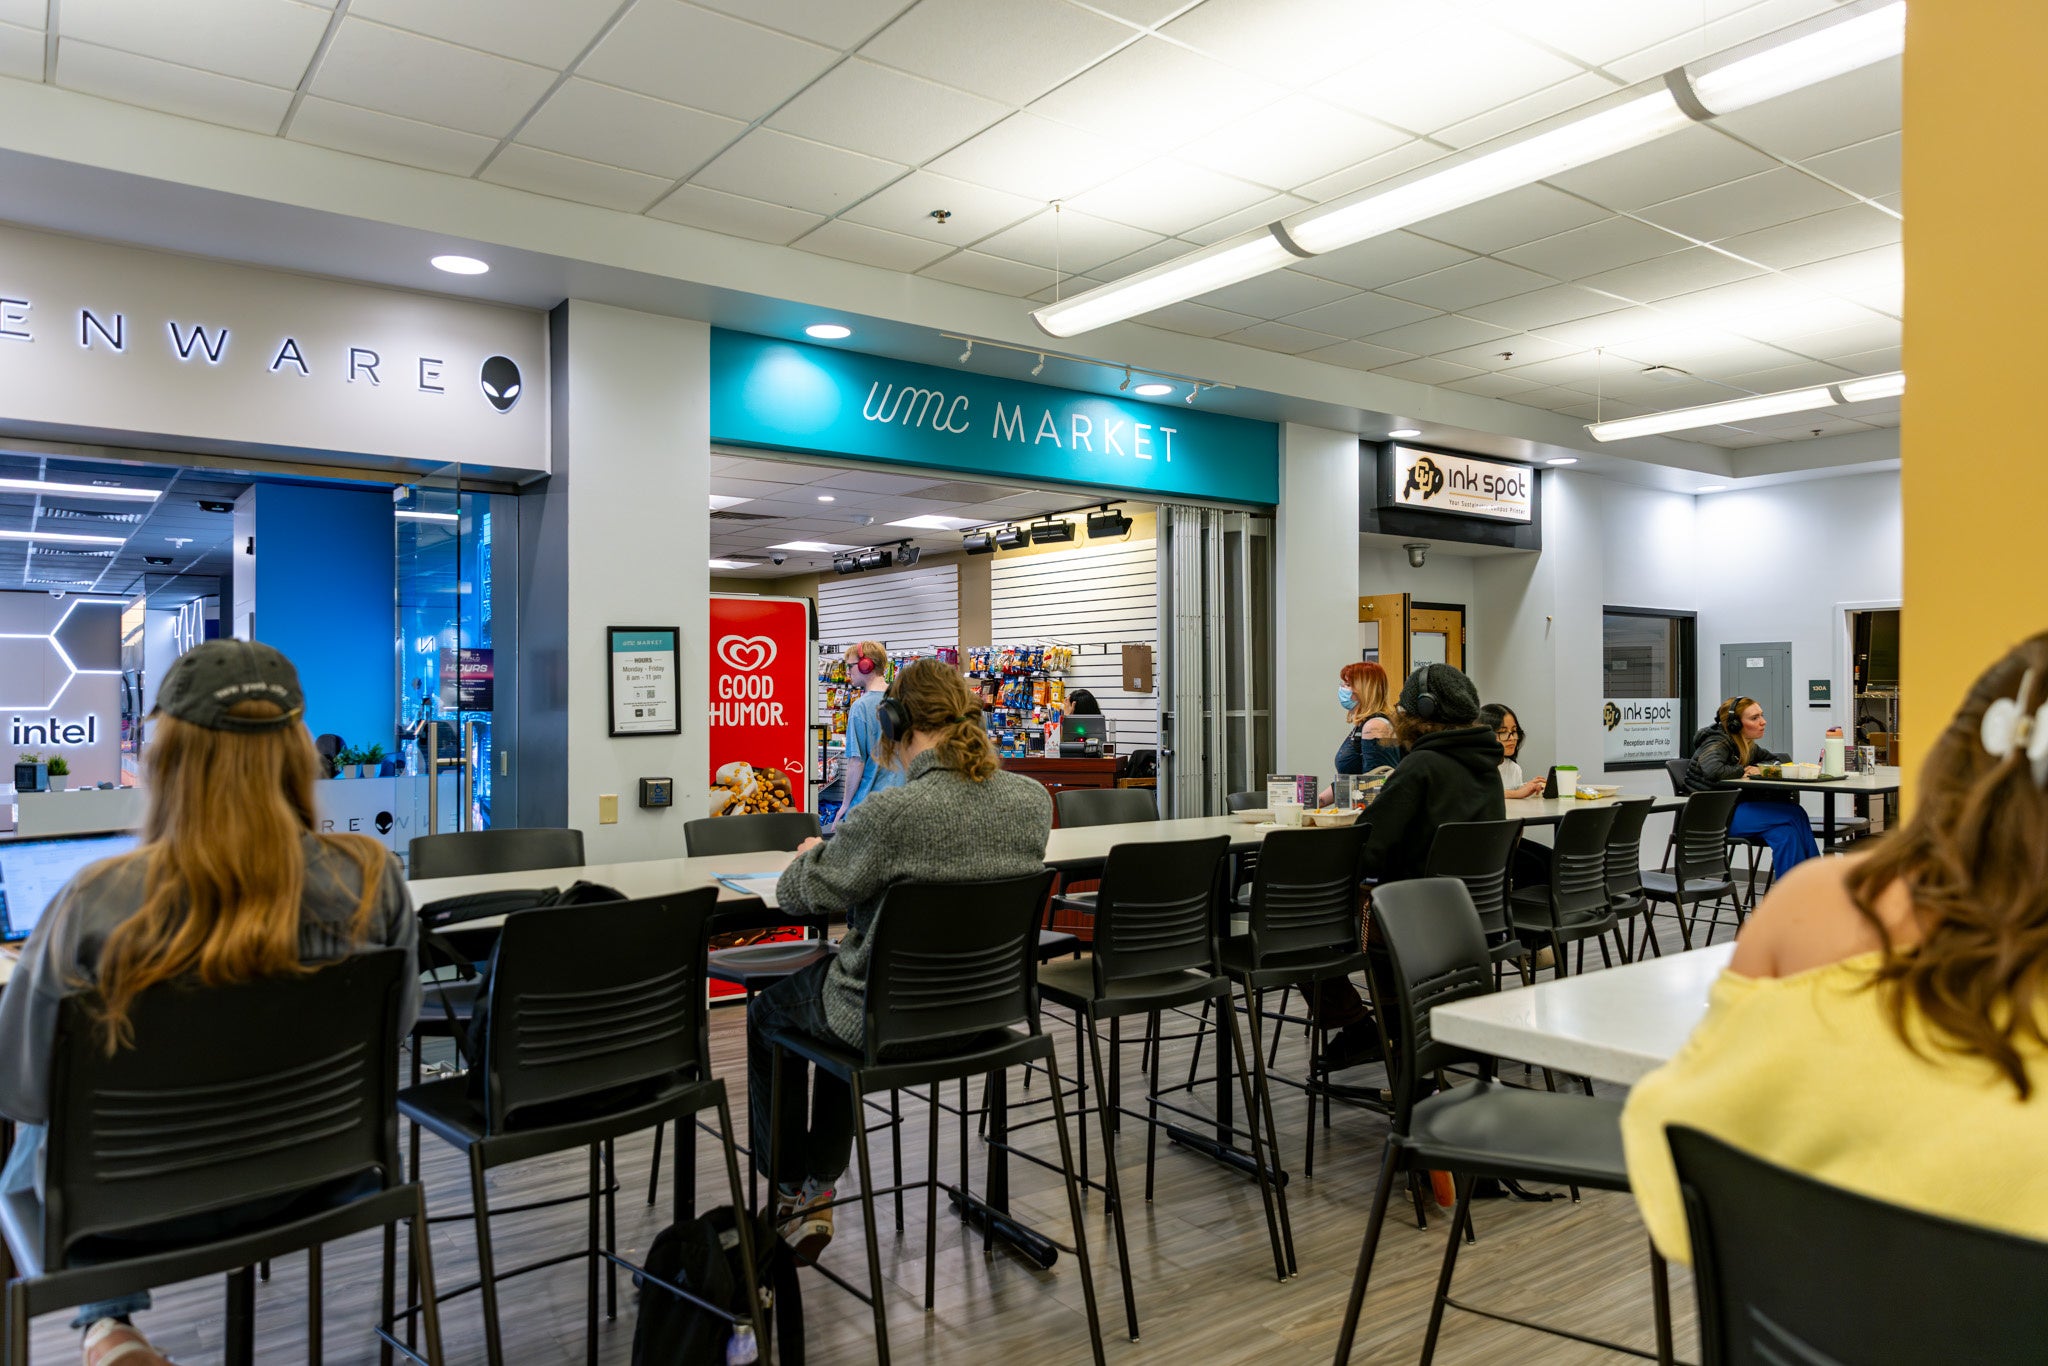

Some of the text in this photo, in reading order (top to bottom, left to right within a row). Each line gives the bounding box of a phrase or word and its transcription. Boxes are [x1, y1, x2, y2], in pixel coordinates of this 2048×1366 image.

[992, 401, 1179, 464] MARKET
[1448, 464, 1526, 502] ink spot
[445, 663, 489, 673] HOURS
[718, 674, 774, 700] GOOD
[1623, 701, 1672, 724] ink spot
[13, 715, 95, 745] intel
[1623, 739, 1645, 747] Reception
[1664, 738, 1670, 746] Up
